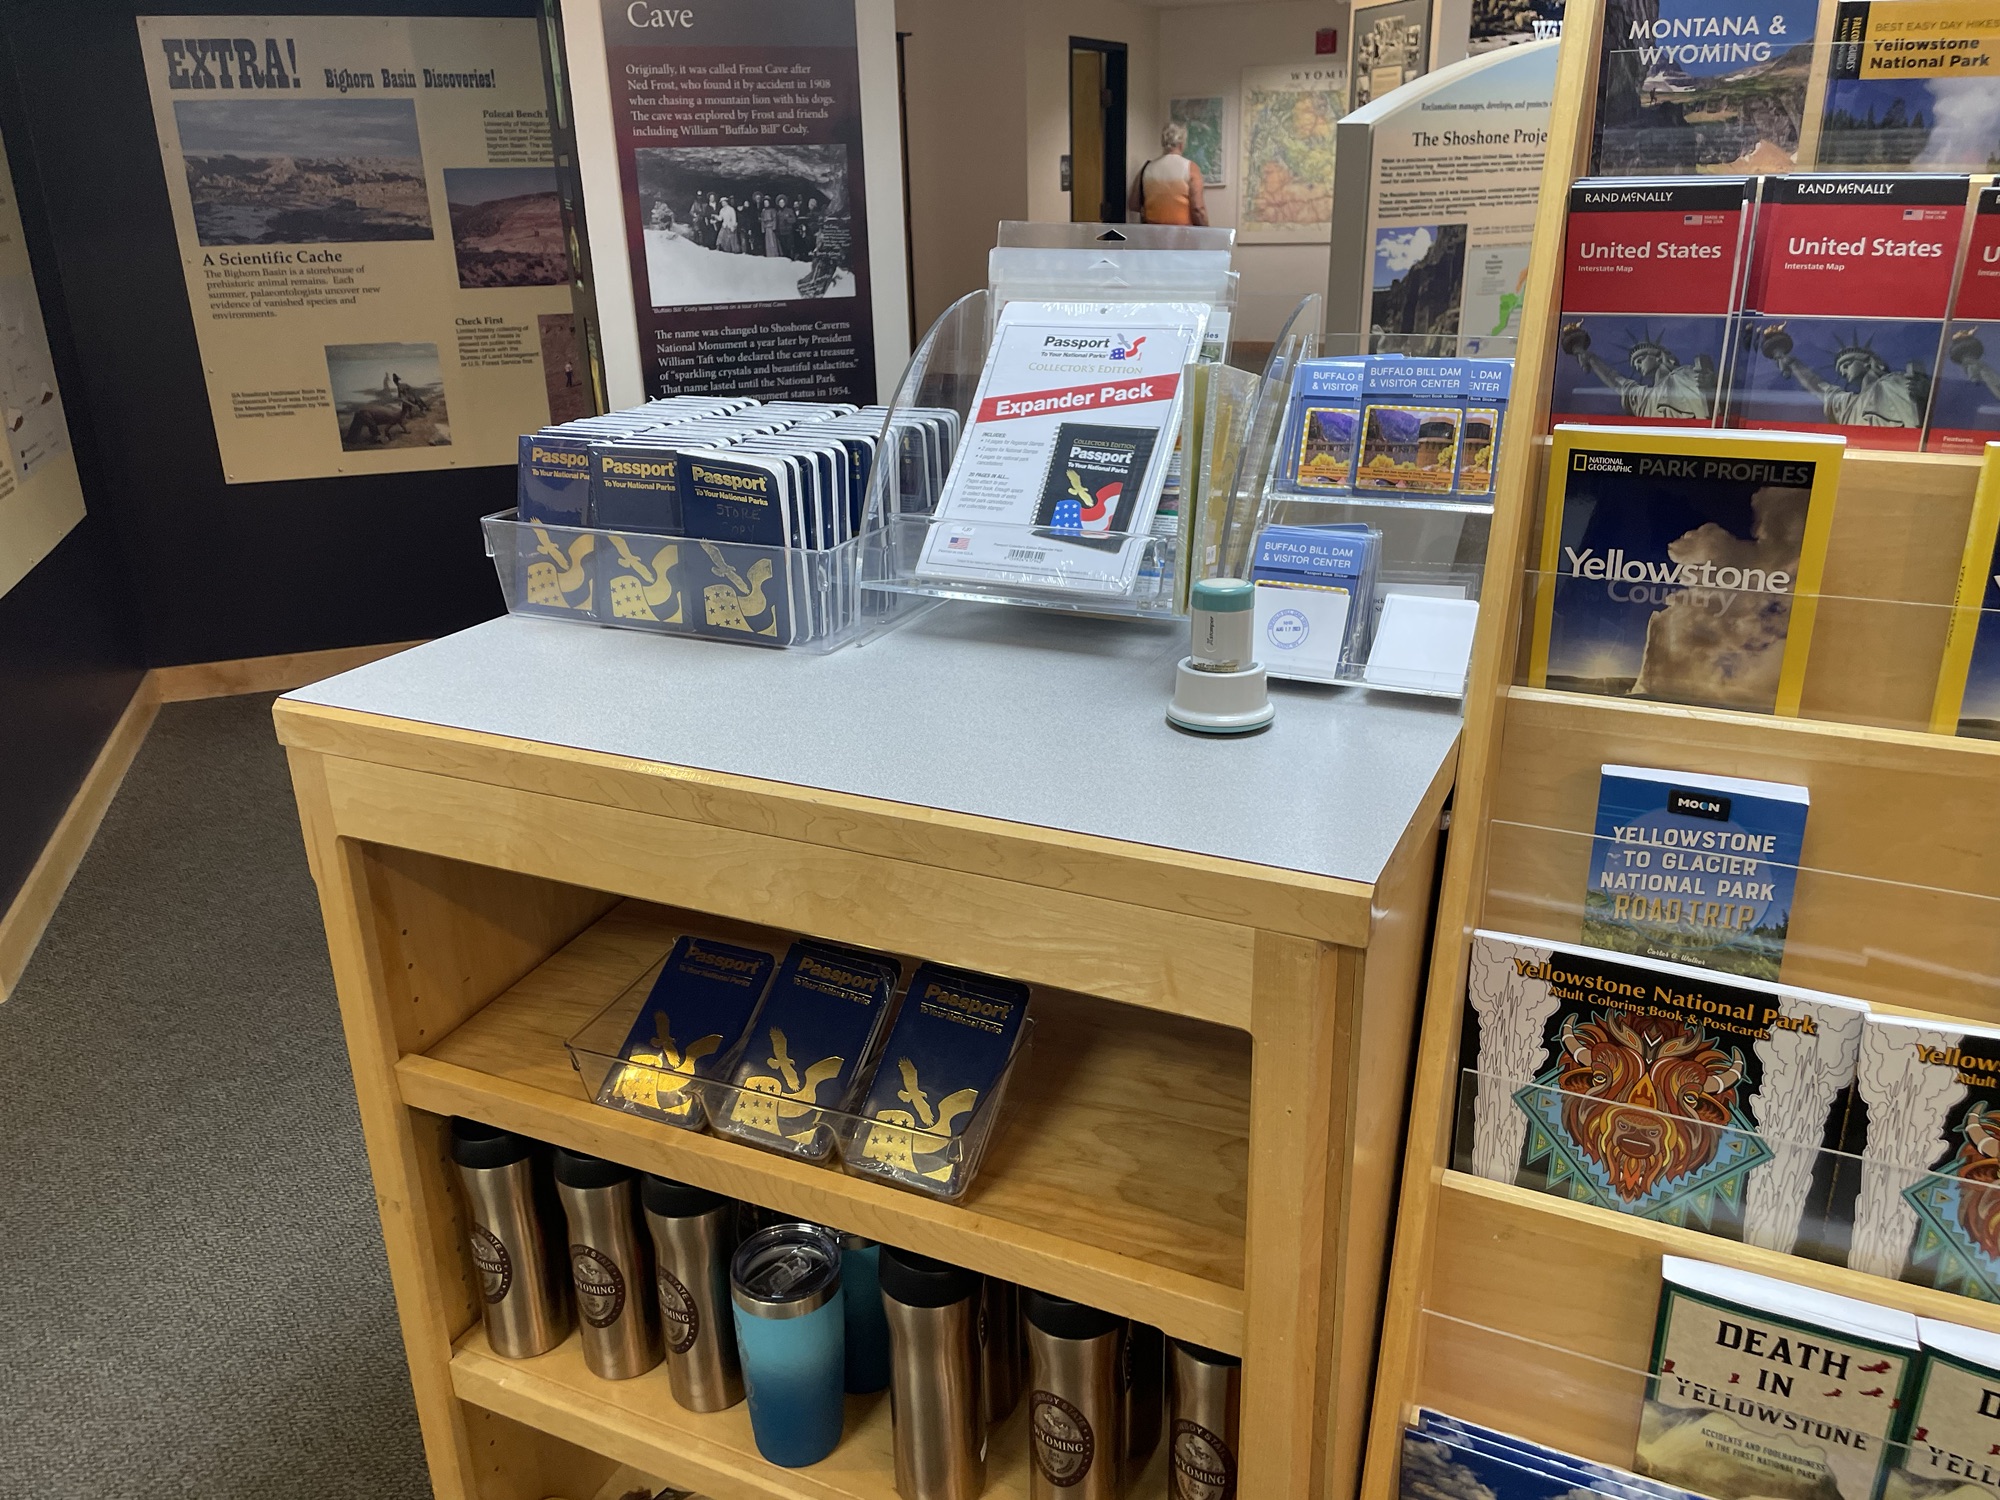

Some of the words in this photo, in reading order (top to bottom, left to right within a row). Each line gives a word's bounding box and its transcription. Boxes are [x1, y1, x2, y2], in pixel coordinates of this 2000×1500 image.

[626, 1, 694, 28] Cave
[1629, 16, 1760, 40] MONTANA
[1769, 15, 1786, 34] &
[1876, 22, 1904, 31] BEST
[1906, 21, 1936, 30] EASY
[1940, 20, 1962, 30] DAY
[1874, 38, 1980, 51] Yellowstone
[1639, 42, 1771, 66] WYOMING
[1870, 55, 1944, 69] National
[1950, 54, 1990, 68] Park
[161, 38, 301, 89] EXTRA!
[626, 64, 677, 78] Originally,
[680, 64, 686, 74] it
[688, 66, 707, 74] was
[708, 64, 737, 74] called
[738, 64, 763, 74] Frost
[764, 64, 788, 74] Cave
[790, 63, 812, 74] after
[324, 69, 374, 92] Bighorn
[381, 69, 417, 88] Basin
[424, 68, 496, 88] Discoveries!
[628, 80, 648, 90] Ned
[650, 80, 678, 91] Frost,
[680, 79, 700, 89] who
[703, 79, 731, 89] found
[734, 80, 740, 89] it
[742, 79, 754, 92] by
[756, 79, 795, 89] accident
[797, 79, 807, 89] in
[809, 79, 831, 88] 1908
[483, 110, 514, 119] Polecat
[516, 110, 543, 119] Bench
[1412, 132, 1439, 147] The
[1442, 130, 1510, 146] Shoshone
[1798, 183, 1835, 194] RAND
[1585, 193, 1619, 203] RAND
[1580, 241, 1651, 259] United
[1657, 242, 1722, 259] States
[1788, 237, 1866, 256] United
[1871, 238, 1942, 257] States
[203, 253, 215, 266] A
[219, 251, 293, 266] Scientific
[296, 250, 342, 264] Cache
[1784, 262, 1824, 271] Interstate
[1826, 263, 1845, 272] Map
[204, 270, 222, 279] The
[224, 269, 260, 280] Bighorn
[262, 268, 287, 277] Basin
[290, 268, 297, 276] is
[306, 266, 354, 275] storehouse
[356, 265, 365, 274] of
[1616, 265, 1633, 273] Map
[455, 317, 482, 326] Check
[484, 316, 503, 324] First
[655, 330, 672, 340] The
[674, 331, 700, 339] name
[721, 326, 757, 337] changed
[760, 326, 768, 334] to
[771, 323, 812, 333] Shoshone
[815, 321, 850, 331] Caverns
[656, 343, 695, 353] National
[698, 340, 748, 351] Monument
[757, 340, 775, 350] year
[778, 338, 797, 347] later
[799, 337, 810, 347] by
[812, 334, 852, 344] President
[1044, 336, 1110, 349] Passport
[1098, 364, 1142, 374] EDITION
[1371, 367, 1414, 376] BUFFALO
[1416, 368, 1436, 376] BILL
[1440, 368, 1461, 376] DAM
[1370, 379, 1376, 387] &
[1380, 379, 1417, 387] VISITOR
[1421, 379, 1460, 388] CENTER
[996, 392, 1095, 416] Expander
[1100, 383, 1154, 403] Pack
[1070, 446, 1133, 464] Passport
[1110, 442, 1136, 450] EDITION
[602, 457, 675, 478] Passport
[1087, 464, 1110, 472] National
[1588, 464, 1632, 473] GEOGRAPHIC
[1589, 457, 1623, 465] NATIONAL
[692, 466, 766, 492] Passport
[1638, 459, 1699, 478] PARK
[1702, 464, 1808, 484] PROFILES
[627, 481, 655, 490] National
[656, 483, 676, 491] Parks
[695, 488, 703, 496] To
[704, 490, 719, 498] Your
[719, 492, 748, 502] National
[749, 496, 768, 506] Parks
[1265, 542, 1306, 553] BUFFALO
[1310, 545, 1328, 555] BILL
[1332, 548, 1353, 557] DAM
[1263, 552, 1269, 561] &
[1273, 554, 1309, 564] VISITOR
[1313, 557, 1351, 568] CENTER
[1564, 547, 1790, 594] Yellowstone
[1608, 581, 1737, 617] Country
[1678, 798, 1720, 812] MOON
[1613, 826, 1777, 854] YELLOWSTONE
[1623, 850, 1651, 868] TO
[1662, 852, 1758, 876] GLACIER
[1601, 872, 1705, 895] NATIONAL
[1717, 879, 1776, 901] PARK
[1613, 895, 1681, 924] ROAD
[1688, 900, 1755, 929] TRIP
[684, 946, 760, 975] Passport
[798, 957, 878, 992] Passport
[924, 984, 1010, 1020] Passport
[1513, 958, 1646, 999] Yellowstone
[1654, 985, 1754, 1021] National
[1762, 1007, 1817, 1034] Park
[1548, 986, 1584, 1001] Adult
[1588, 993, 1645, 1017] Coloring
[1650, 1005, 1683, 1022] Book
[1687, 1014, 1697, 1024] &
[1703, 1016, 1770, 1040] Postcards
[1715, 1320, 1850, 1380] DEATH
[1757, 1368, 1794, 1398] IN
[1676, 1376, 1867, 1450] YELLOWSTONE
[1034, 1424, 1084, 1452] WYOMING
[1174, 1453, 1225, 1485] WYOMING
